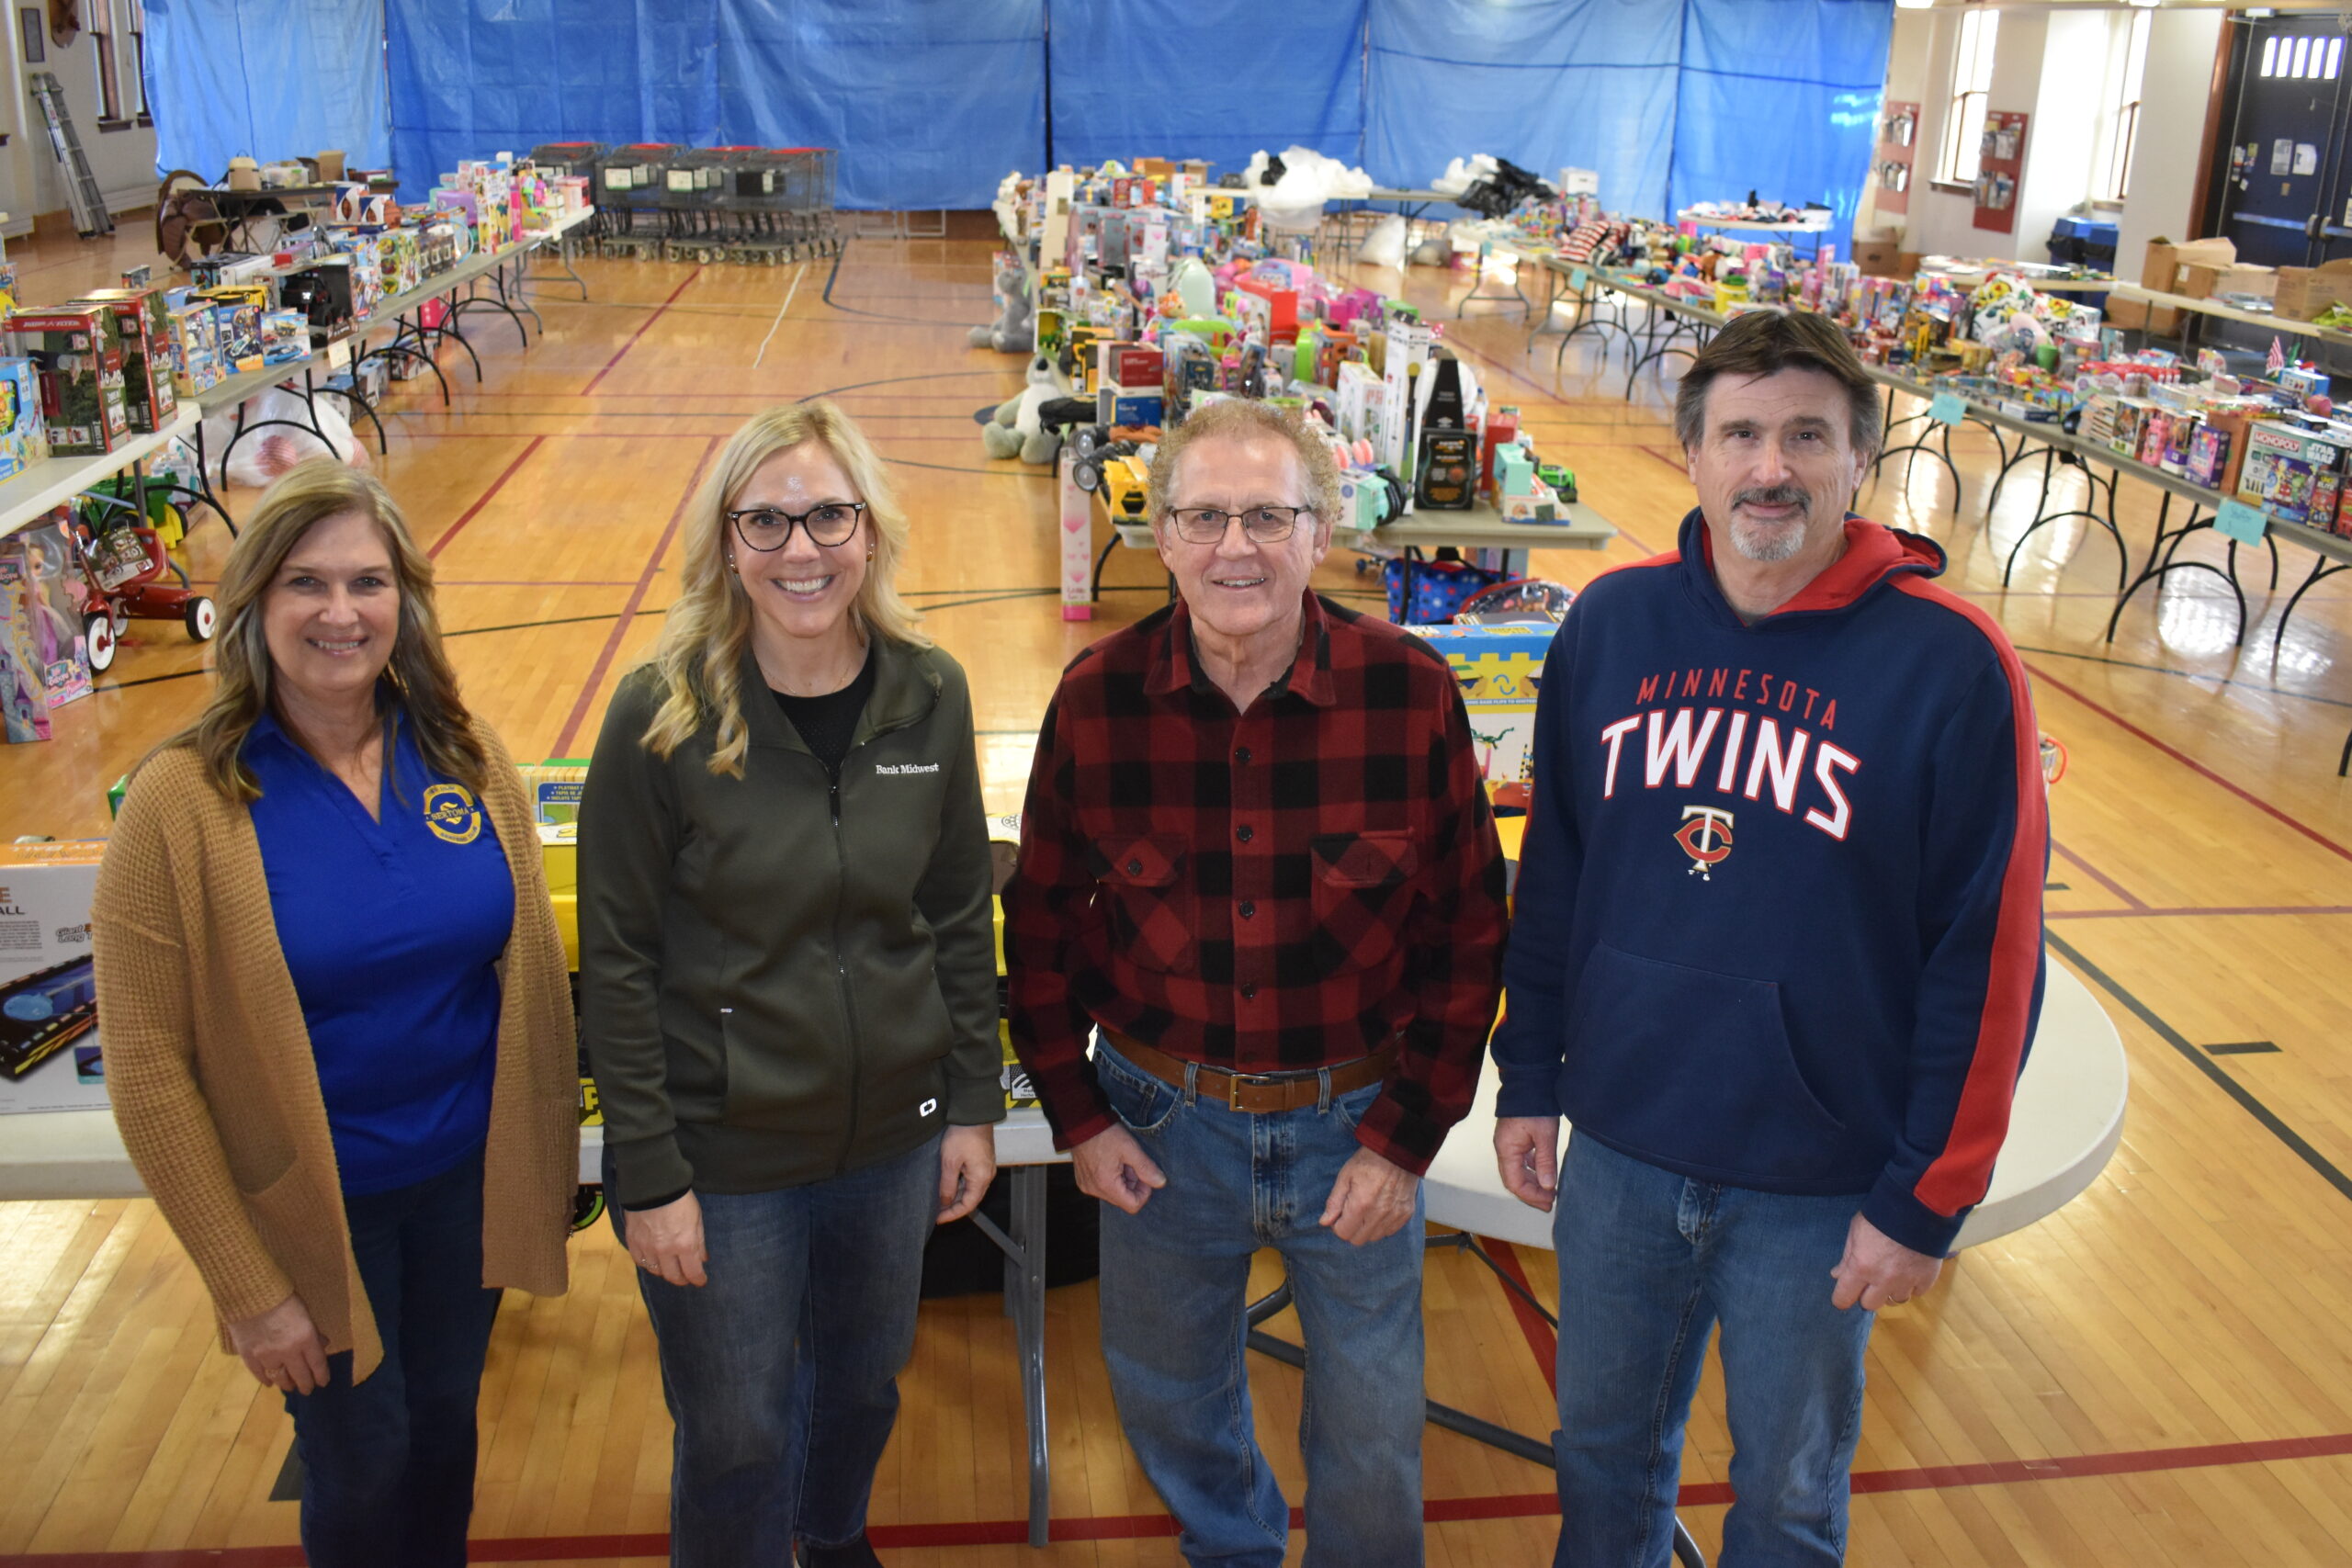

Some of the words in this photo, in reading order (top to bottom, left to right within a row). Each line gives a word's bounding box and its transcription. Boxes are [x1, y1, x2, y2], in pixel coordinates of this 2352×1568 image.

[2254, 431, 2300, 452] MONOPOLY
[2307, 443, 2335, 455] STAR
[2307, 451, 2335, 464] WARS
[1635, 668, 1838, 731] MINNESOTA
[876, 764, 899, 774] Bank
[899, 762, 940, 774] Midwest
[1600, 706, 1862, 842] TWINS
[431, 807, 469, 820] SERTOMA
